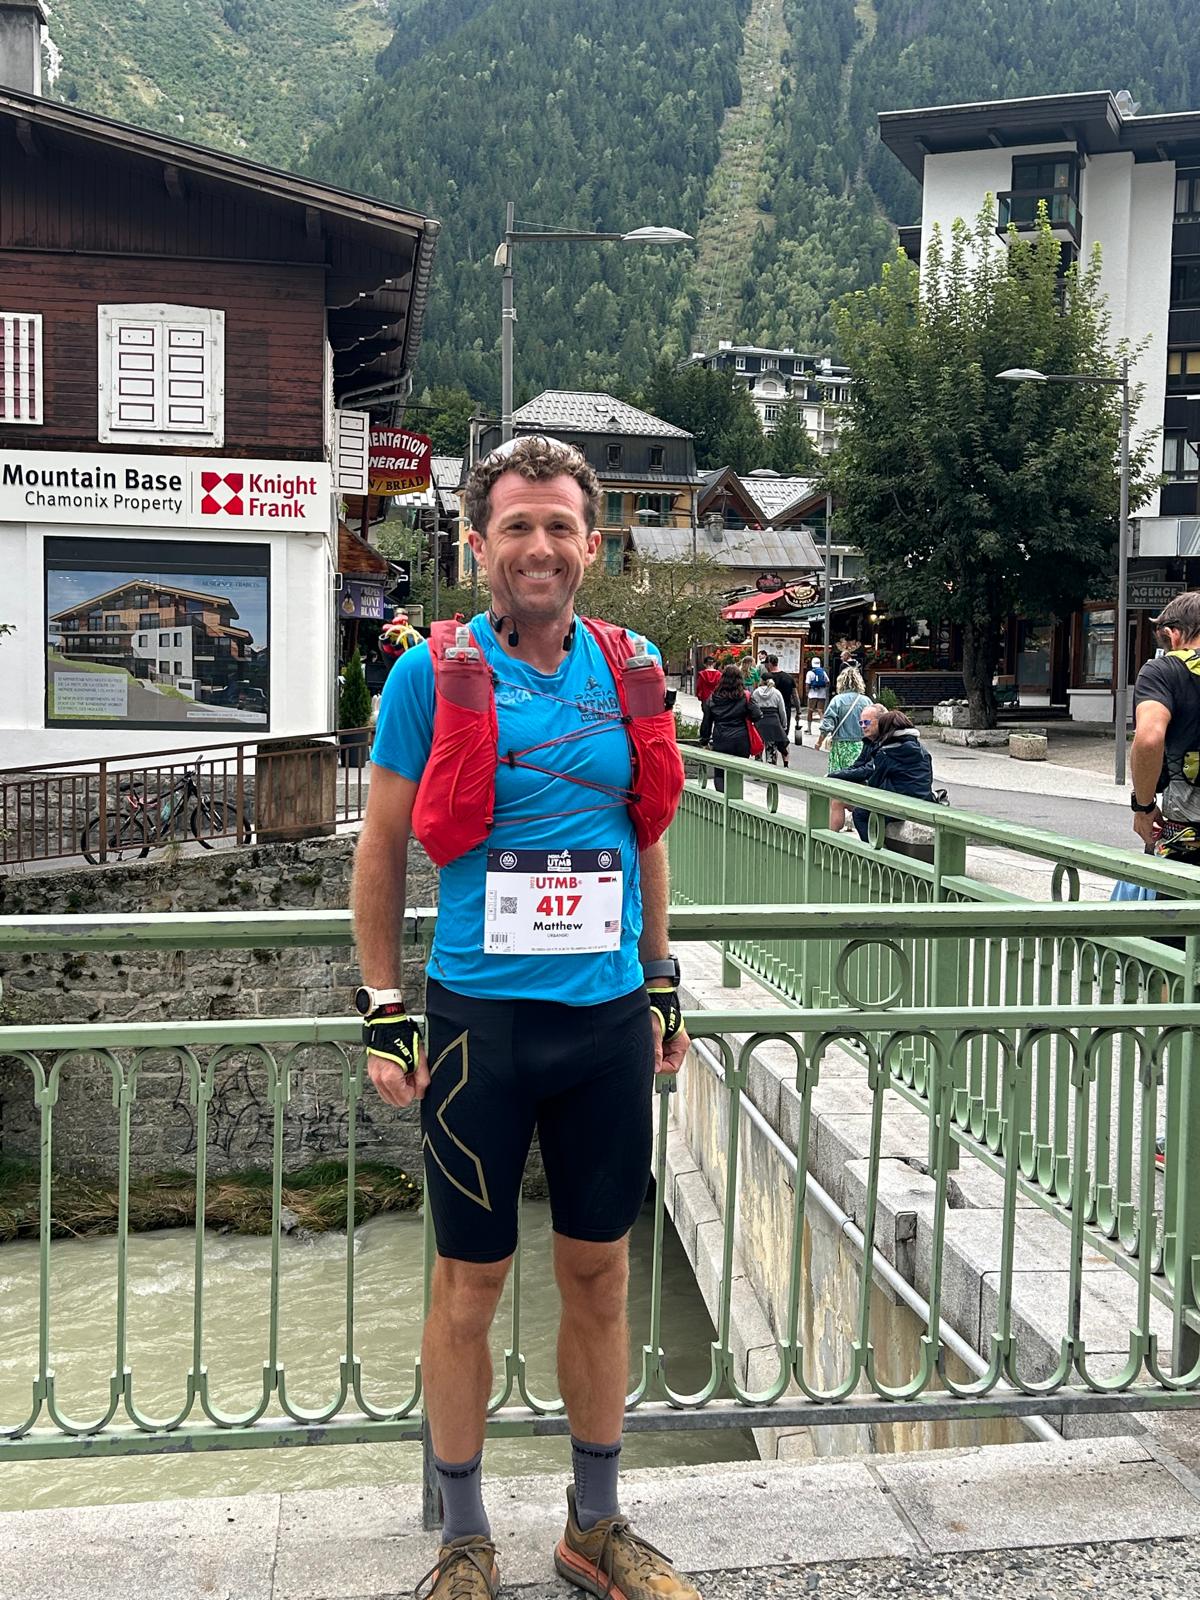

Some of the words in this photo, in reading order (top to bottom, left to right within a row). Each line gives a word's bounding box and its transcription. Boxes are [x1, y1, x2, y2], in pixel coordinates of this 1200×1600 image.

[369, 456, 420, 470] NÉRALE
[3, 464, 116, 488] Mountain
[125, 468, 182, 491] Base
[386, 476, 424, 490] BREAD
[249, 473, 317, 499] Knight
[25, 490, 108, 508] Chamonix
[114, 494, 182, 514] Property
[249, 498, 306, 518] Frank
[1131, 586, 1177, 597] AGENCE
[361, 596, 380, 607] MONT
[361, 607, 381, 617] BLANC
[547, 858, 572, 867] UTMB
[536, 876, 578, 889] UTMB
[536, 895, 583, 916] 417
[533, 921, 583, 931] Matthew
[668, 1006, 677, 1032] LEKI
[393, 1038, 413, 1064] LEKI
